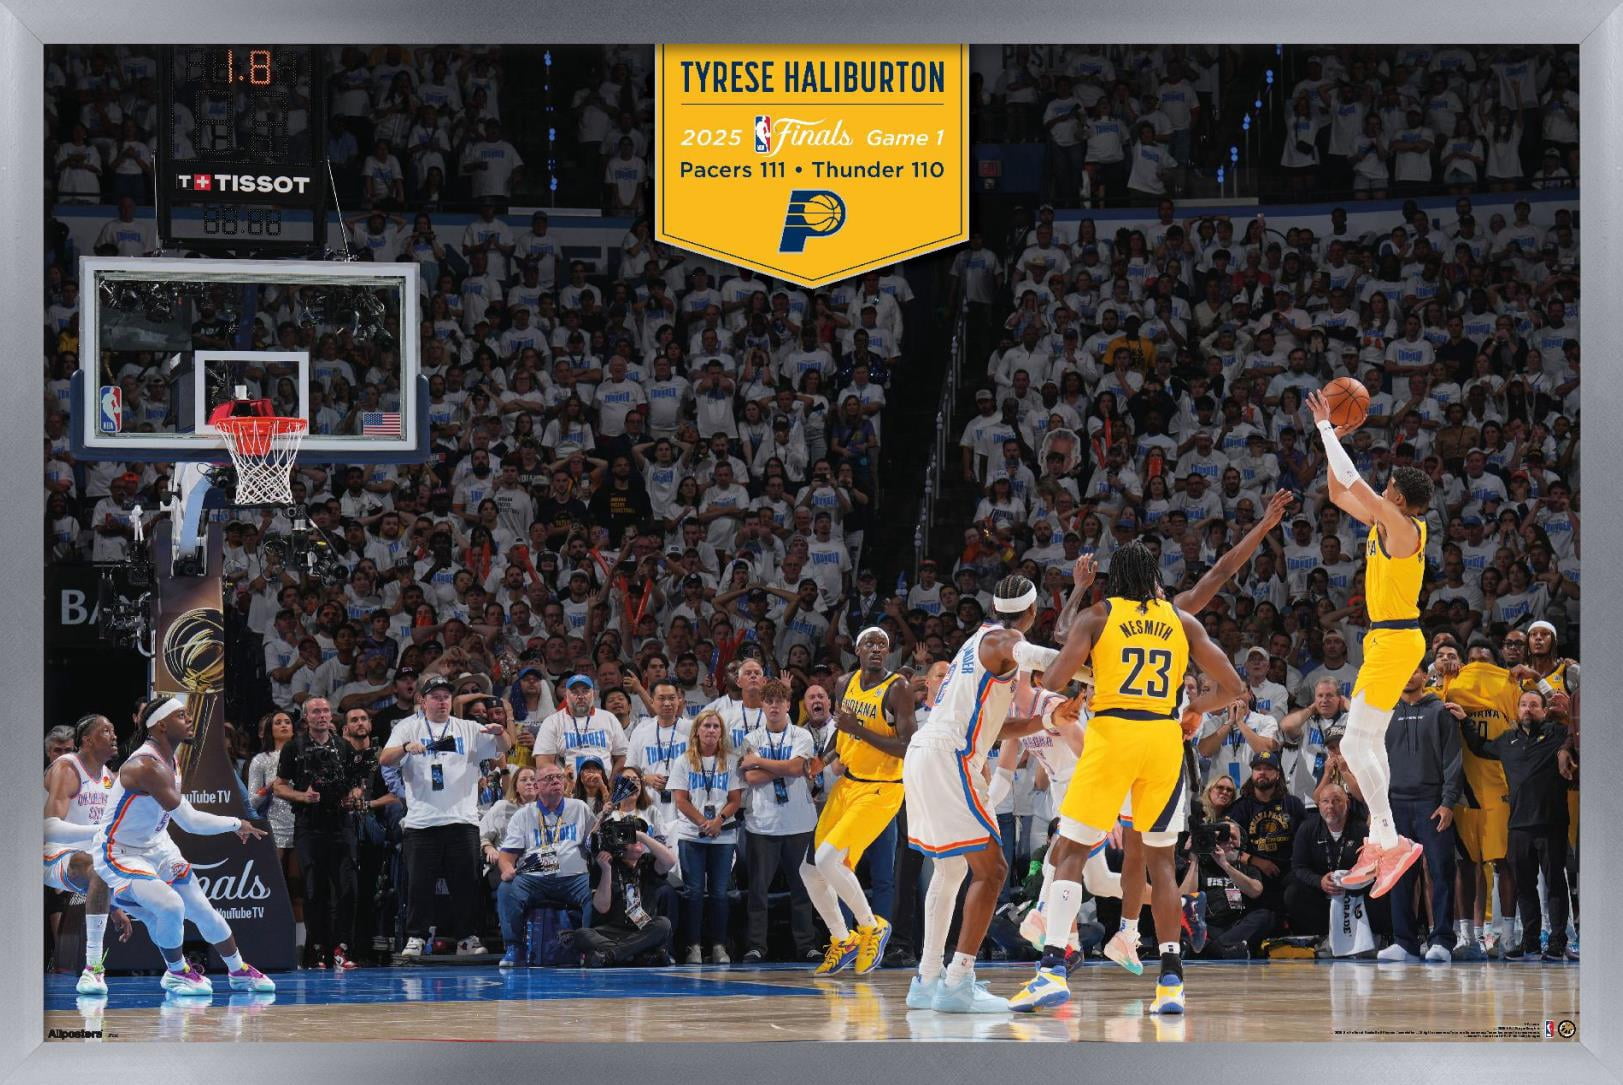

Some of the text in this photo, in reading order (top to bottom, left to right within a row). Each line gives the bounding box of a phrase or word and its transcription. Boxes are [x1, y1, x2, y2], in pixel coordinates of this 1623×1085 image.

[226, 49, 272, 85] 1.8
[214, 174, 311, 194] TISSOT
[1119, 619, 1173, 641] NESMITH
[1119, 647, 1172, 698] 23
[217, 790, 231, 804] TV
[252, 906, 264, 919] TV
